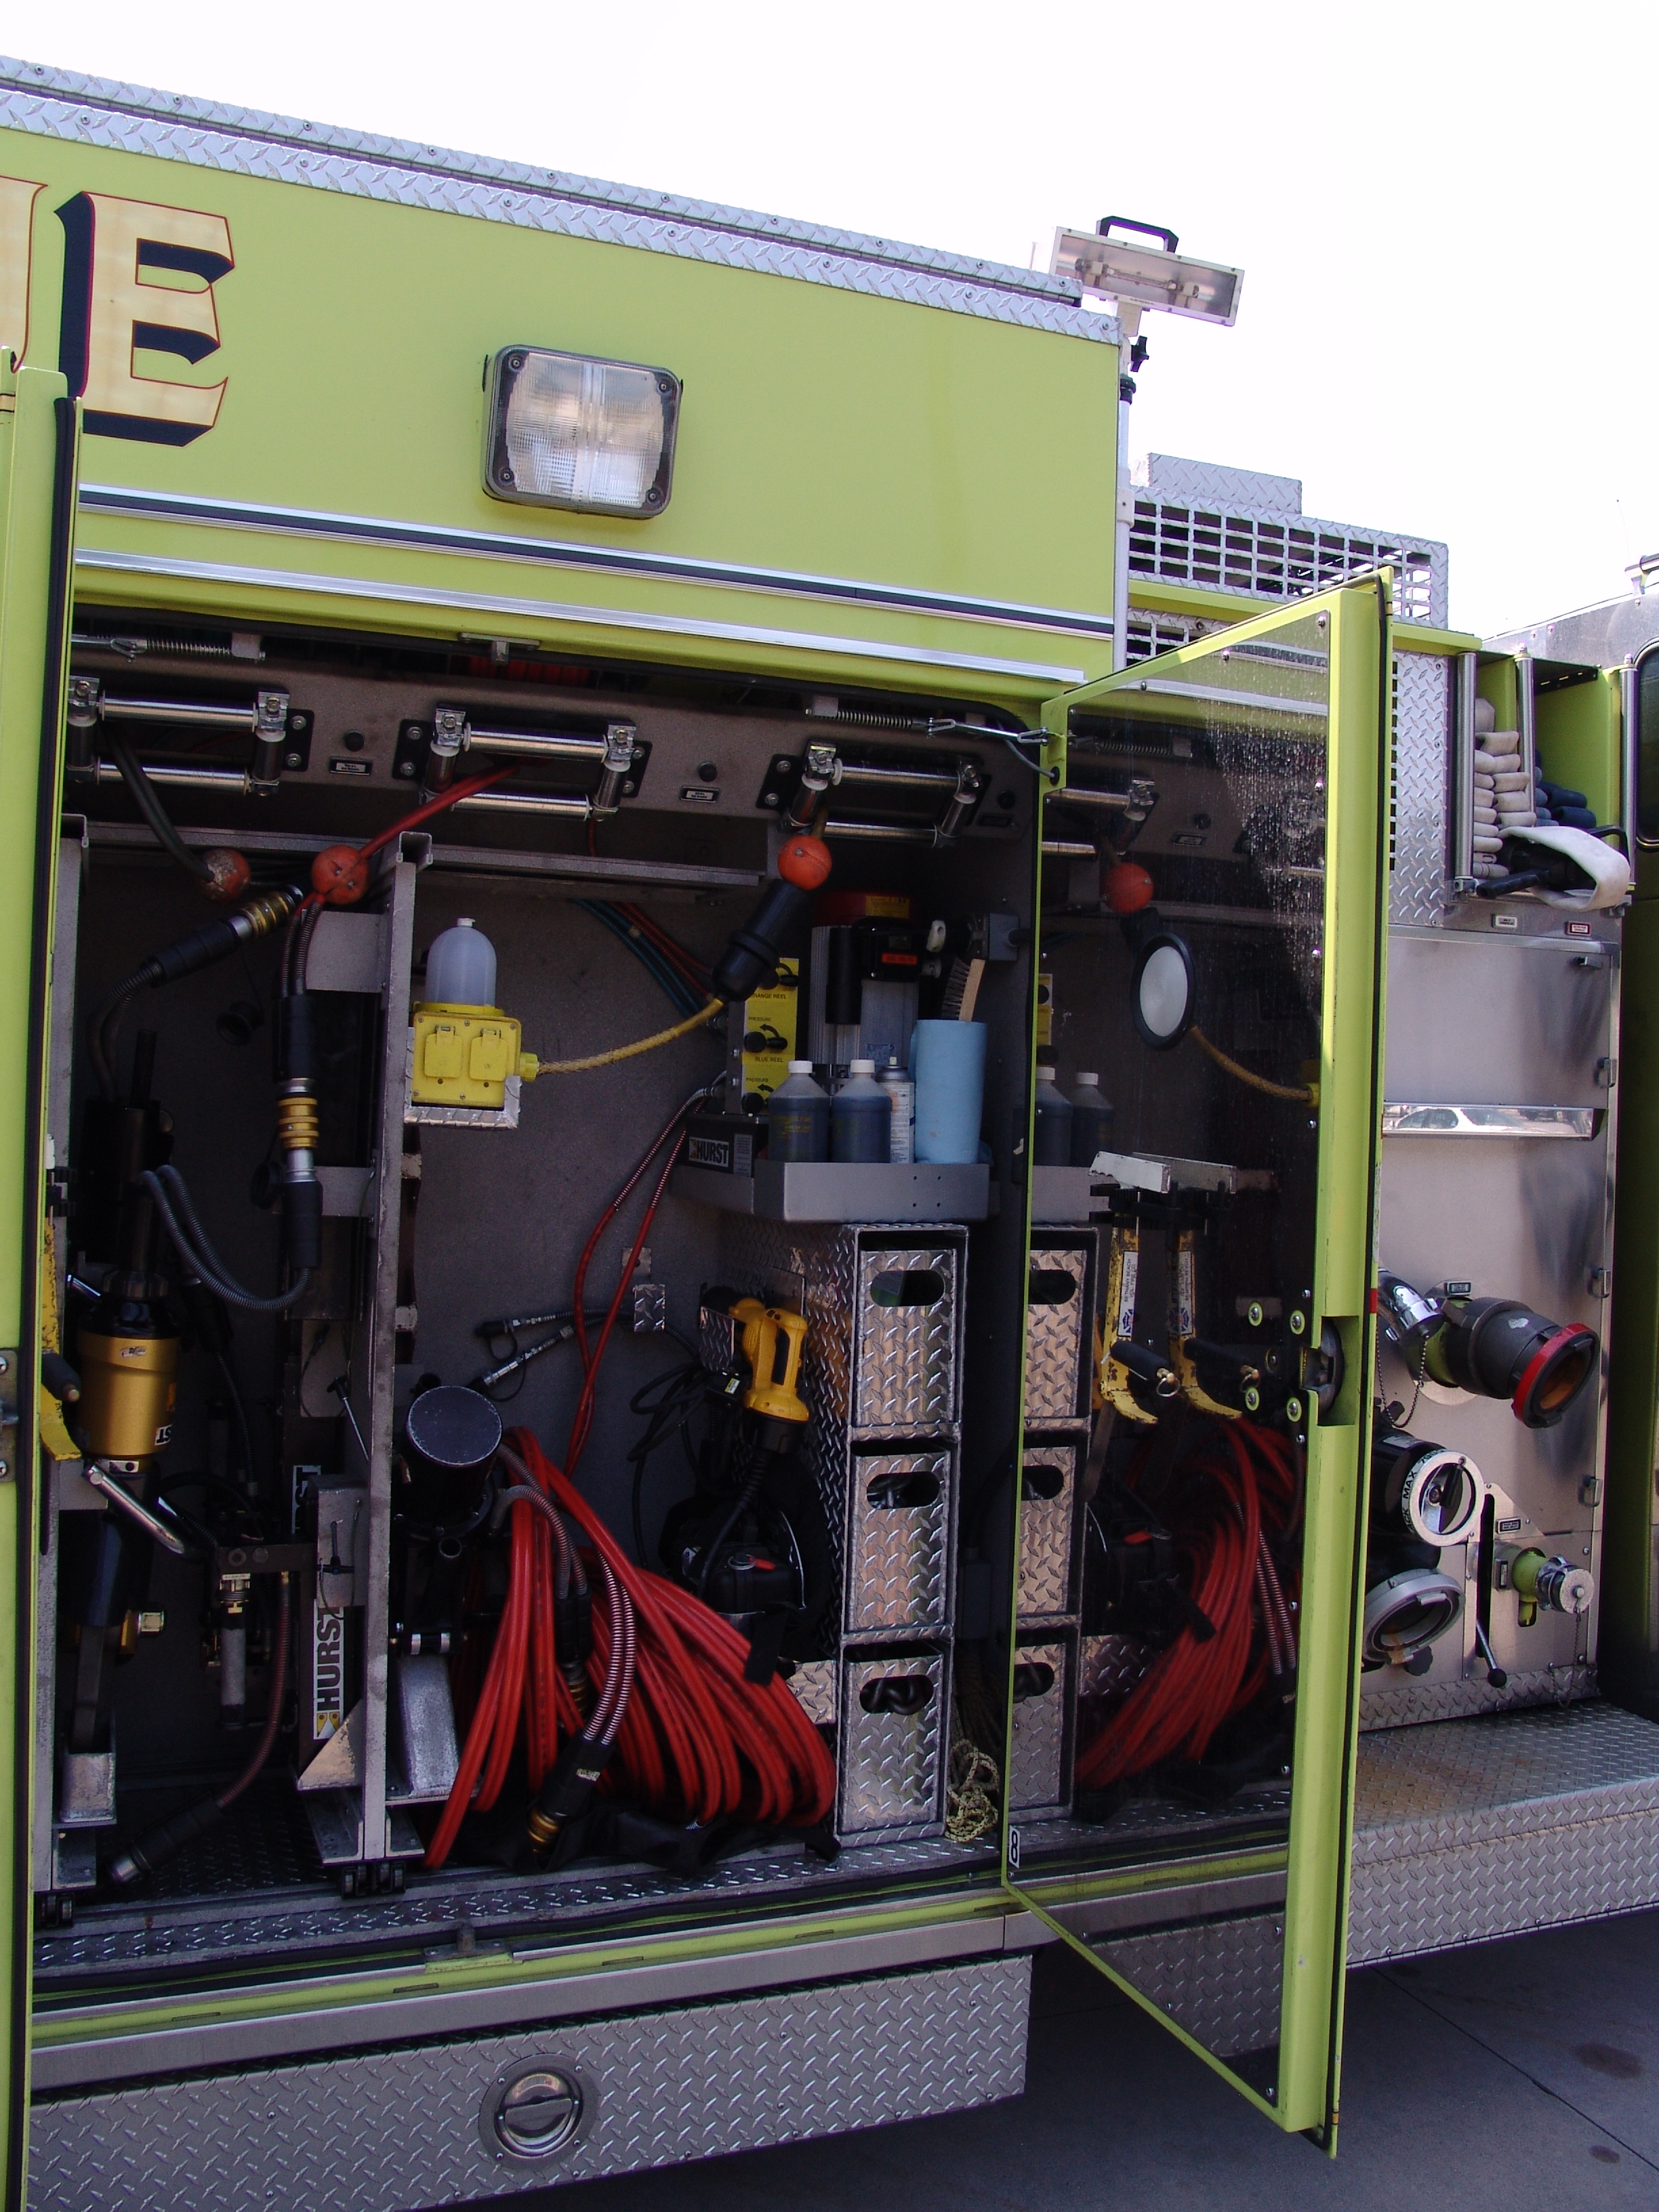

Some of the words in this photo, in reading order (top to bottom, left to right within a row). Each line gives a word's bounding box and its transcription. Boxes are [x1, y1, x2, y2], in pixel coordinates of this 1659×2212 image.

[697, 1140, 729, 1164] HURST
[1403, 1471, 1418, 1500] MAX
[1010, 1830, 1018, 1864] 8
